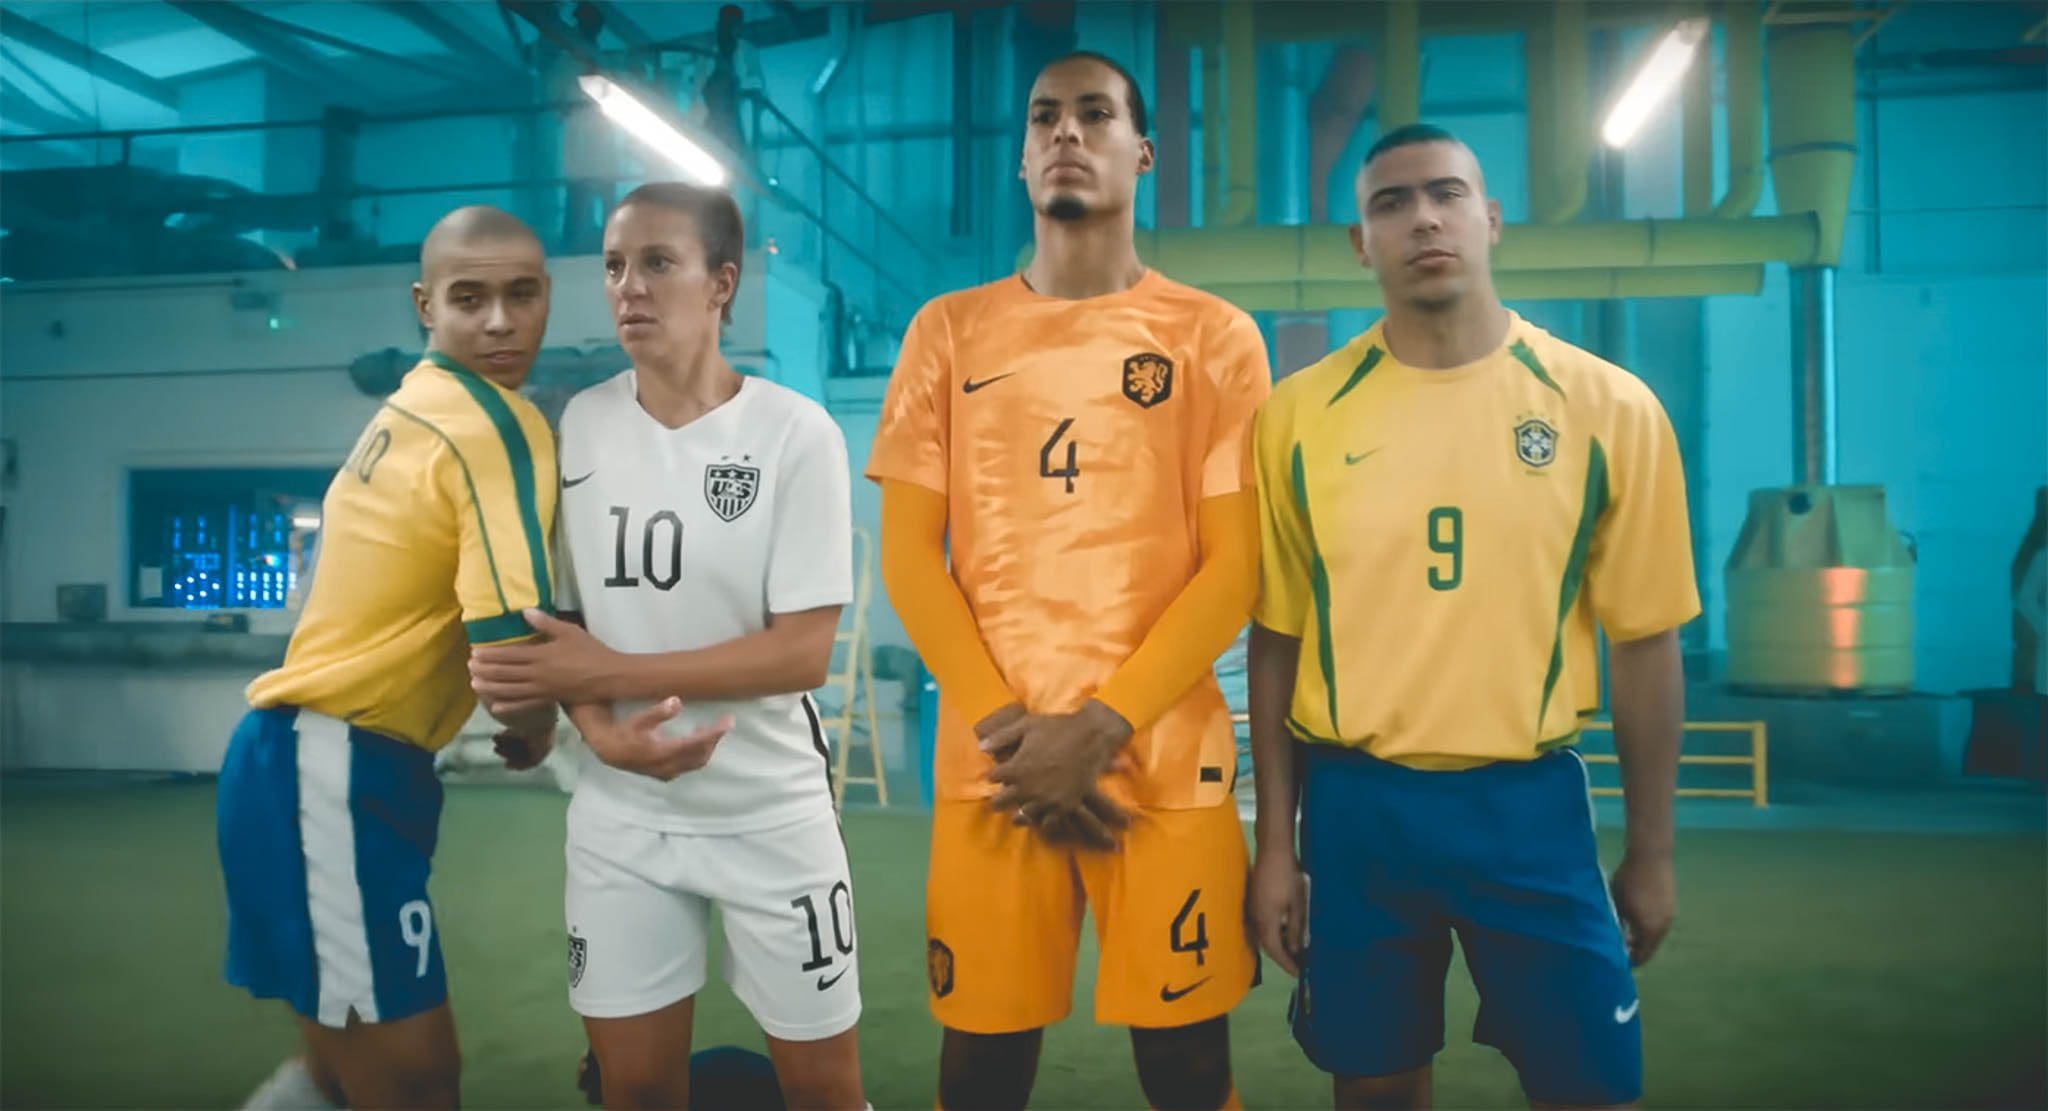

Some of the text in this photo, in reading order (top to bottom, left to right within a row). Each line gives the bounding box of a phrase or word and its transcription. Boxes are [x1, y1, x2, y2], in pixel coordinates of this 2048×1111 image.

[1039, 418, 1080, 493] 4
[604, 505, 684, 591] 10
[1427, 505, 1463, 591] 9
[399, 900, 431, 978] 9
[790, 880, 853, 972] 10
[1170, 888, 1209, 967] 4
